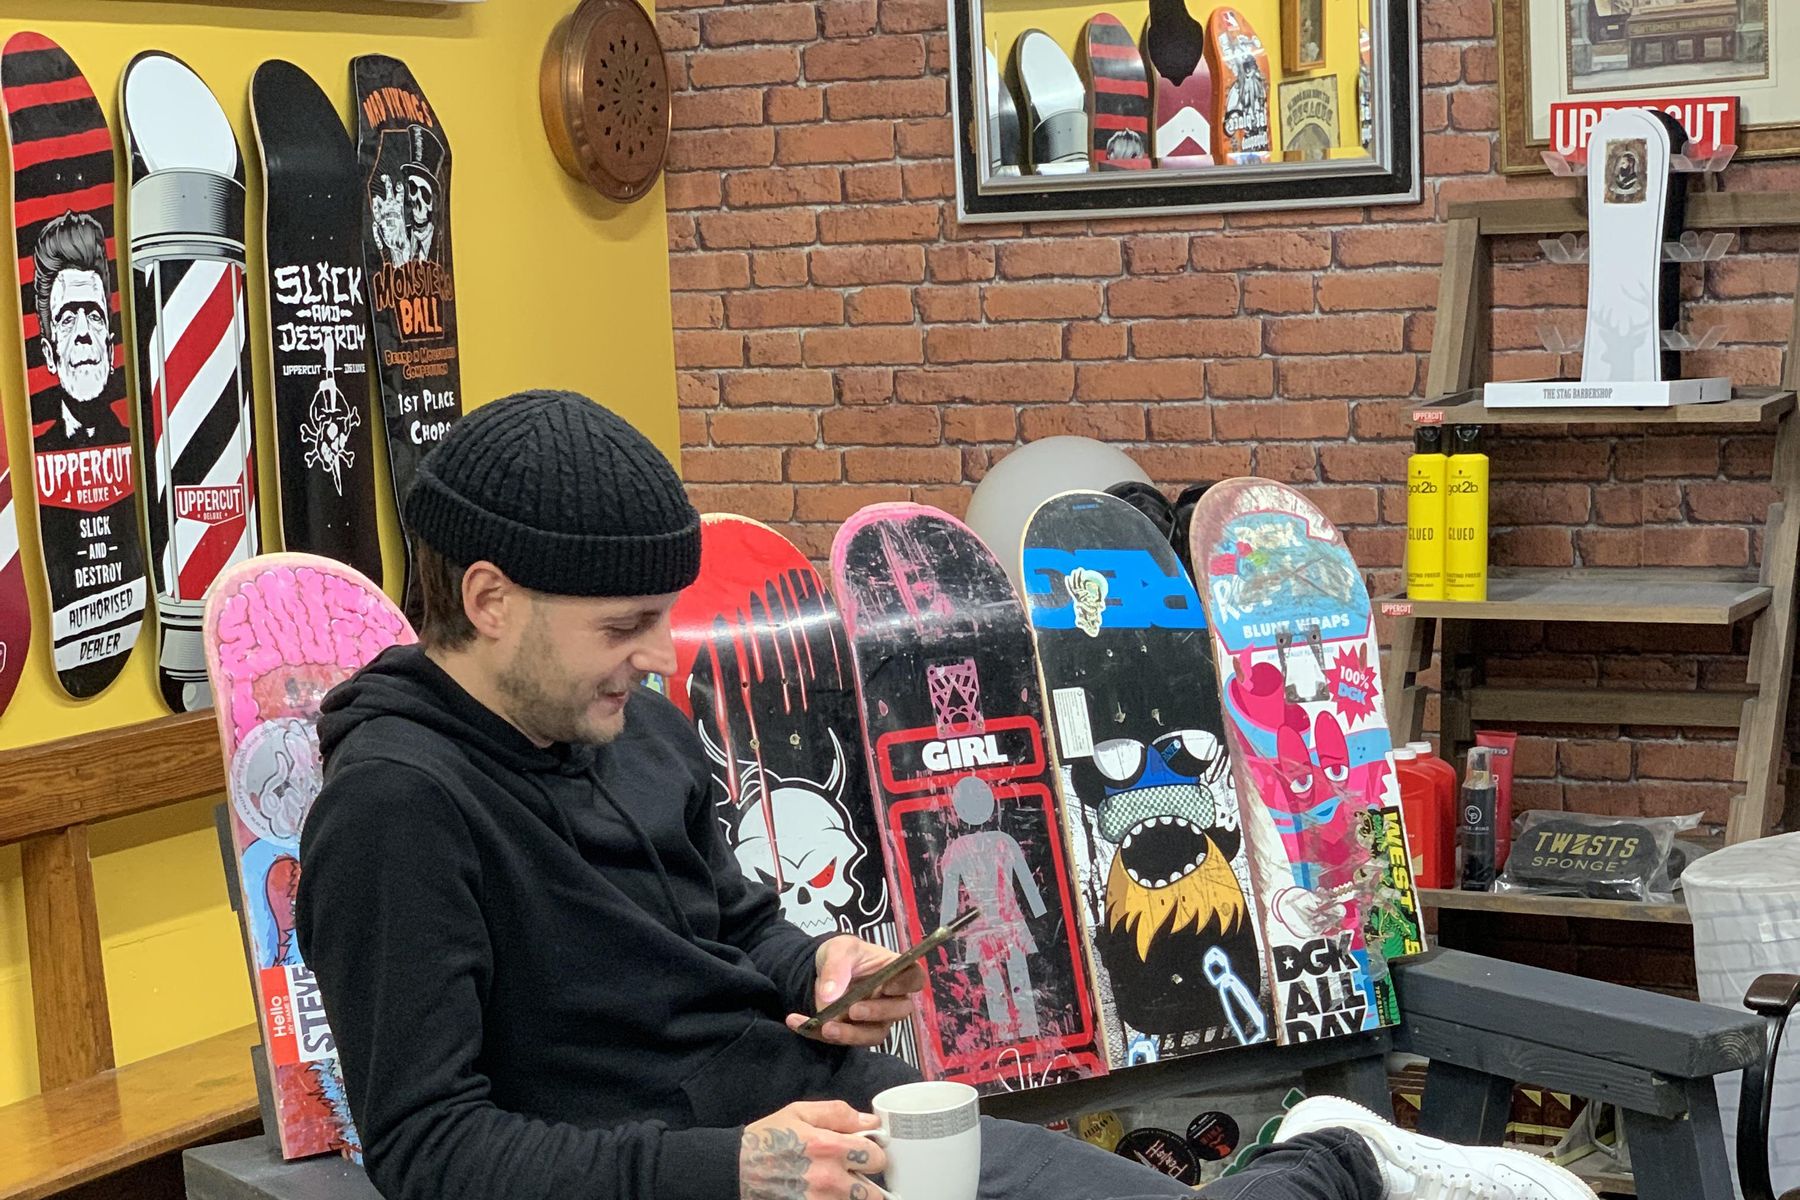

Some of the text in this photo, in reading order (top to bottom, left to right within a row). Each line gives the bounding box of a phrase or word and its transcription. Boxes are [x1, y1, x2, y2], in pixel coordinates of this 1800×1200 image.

[1556, 103, 1728, 155] UPUT
[274, 261, 364, 306] SLICK
[311, 304, 341, 322] AND
[400, 297, 443, 335] BALL
[276, 322, 366, 352] DESTROY
[283, 365, 321, 376] UPPERCUT
[398, 389, 455, 415] 1ST PLACE
[1543, 388, 1613, 399] THE STAG BARBERSHOP
[37, 446, 132, 497] UPPERCUT
[77, 487, 110, 504] DELUXE
[178, 489, 240, 515] UPPERCUT
[80, 516, 112, 538] SLICK
[203, 512, 223, 520] DELUXE
[89, 542, 107, 560] AND
[75, 562, 122, 588] DESTROY
[69, 588, 133, 629] AUTHORISED
[1243, 613, 1350, 639] BLUNT WRAPS
[79, 633, 121, 661] DEALER
[1340, 666, 1369, 689] 100%
[1338, 681, 1367, 705] DGK
[922, 734, 1008, 771] GIRL
[1383, 812, 1415, 913] WEST
[1531, 856, 1619, 872] SPONGE
[1272, 933, 1358, 982] DGK
[1286, 972, 1366, 1020] ALL
[270, 995, 287, 1037] Hello
[1286, 1007, 1366, 1044] DAY
